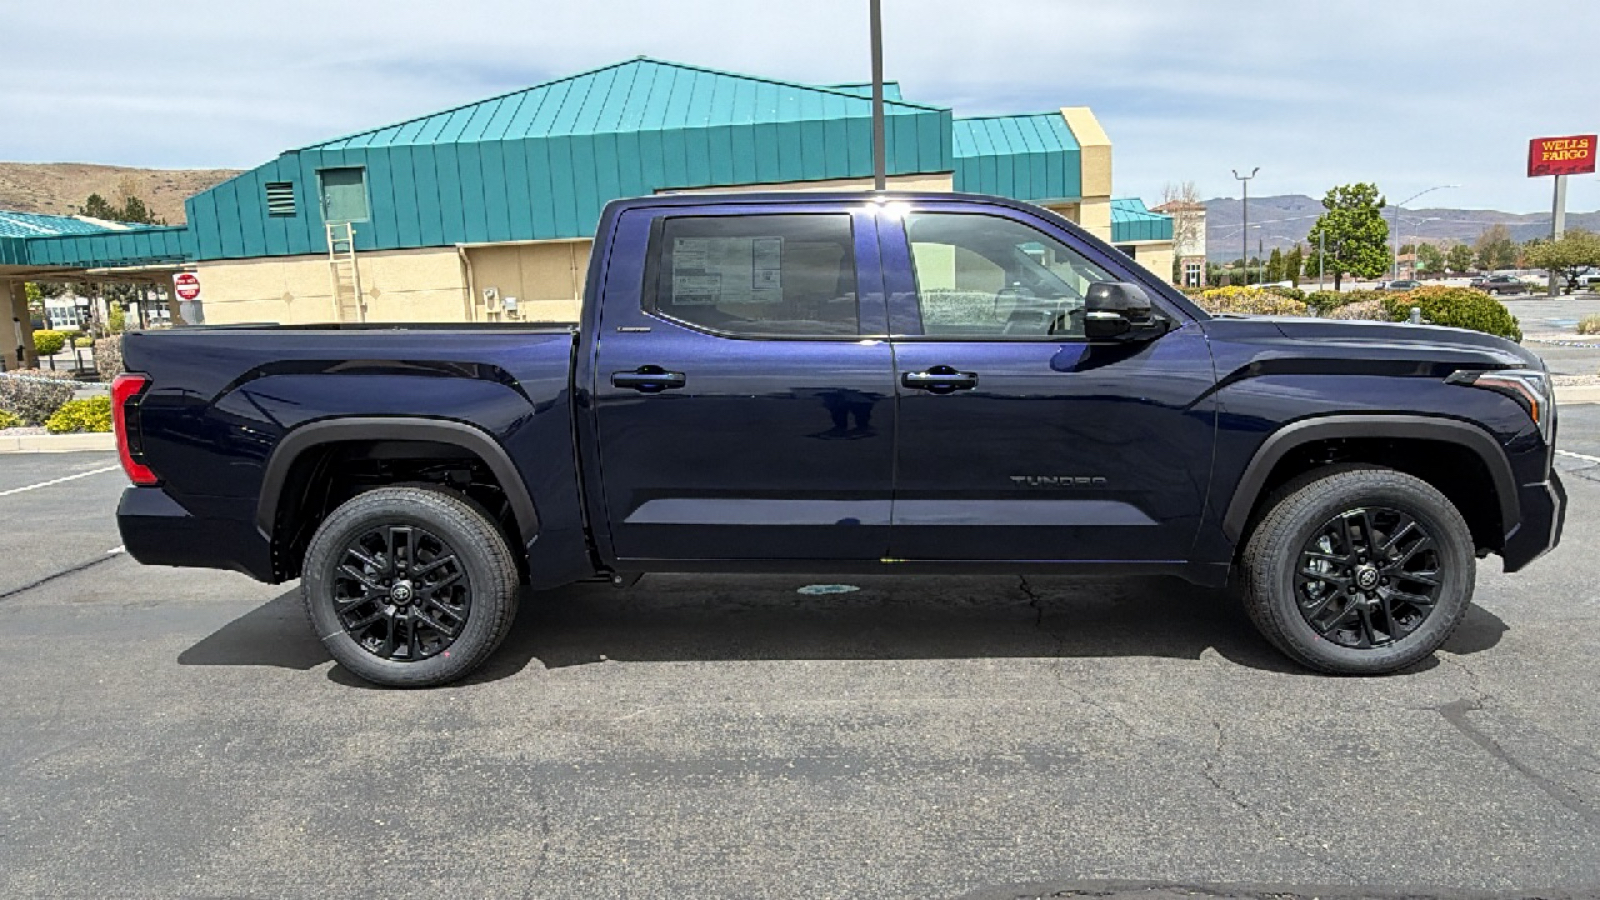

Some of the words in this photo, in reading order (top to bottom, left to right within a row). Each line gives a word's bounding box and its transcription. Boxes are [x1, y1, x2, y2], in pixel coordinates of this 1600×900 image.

[1542, 139, 1589, 150] WELLS
[1542, 150, 1588, 161] FARGO
[1009, 475, 1107, 486] TUNDRA
